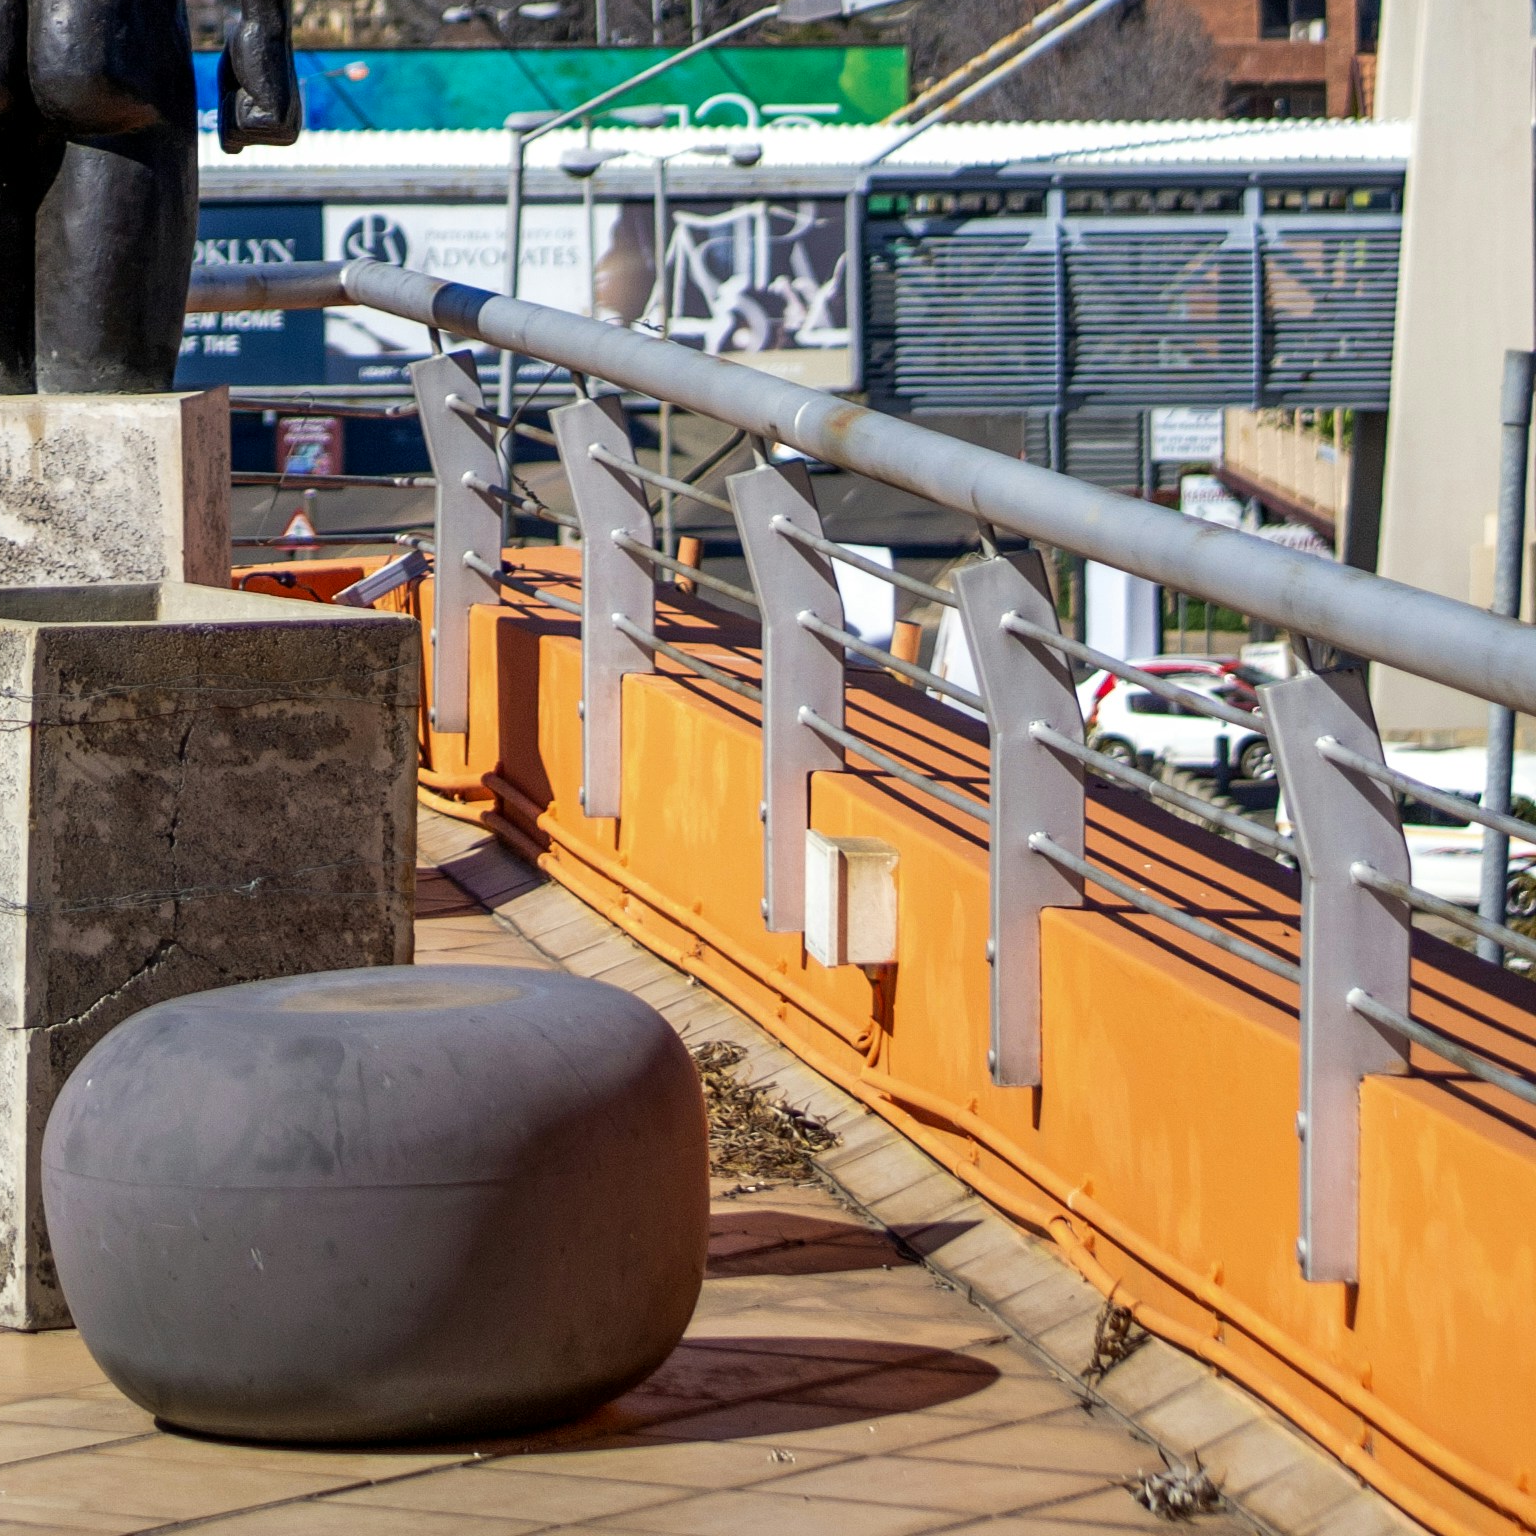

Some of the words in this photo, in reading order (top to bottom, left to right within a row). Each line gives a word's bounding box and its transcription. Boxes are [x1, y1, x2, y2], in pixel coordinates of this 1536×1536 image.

[184, 312, 219, 330] EW
[221, 309, 285, 330] HOME
[202, 334, 241, 356] THE
